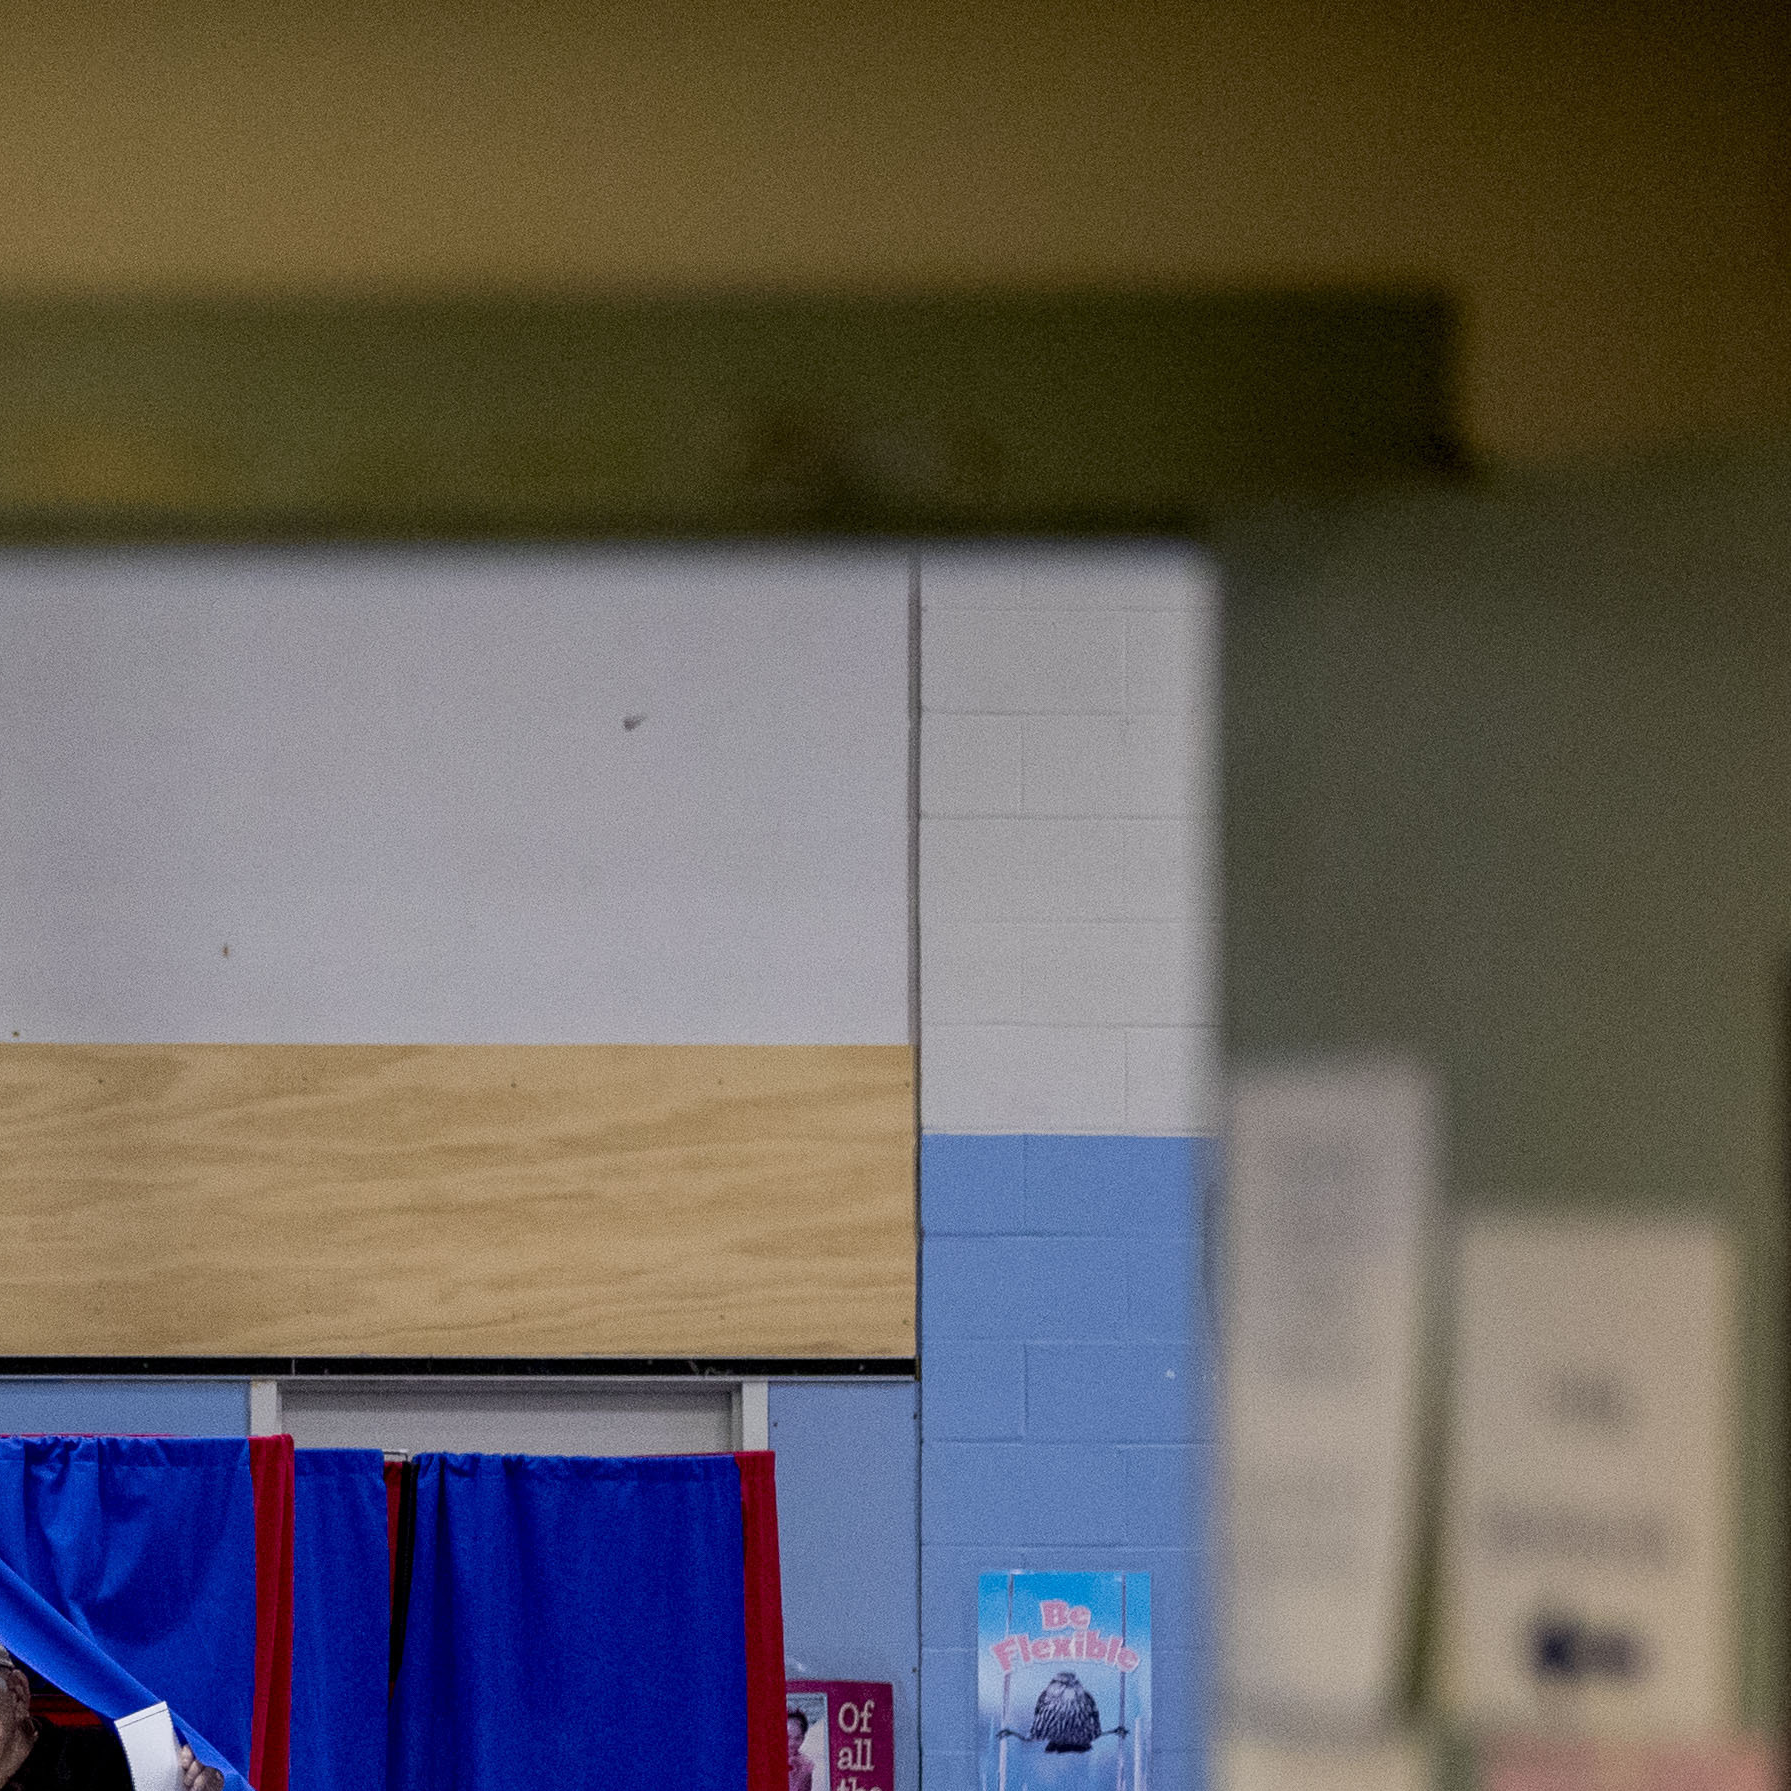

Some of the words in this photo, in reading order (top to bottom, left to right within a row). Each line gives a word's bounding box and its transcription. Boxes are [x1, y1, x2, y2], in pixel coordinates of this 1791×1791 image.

[1040, 1599, 1092, 1630] Be
[991, 1630, 1140, 1672] Flexible
[837, 1699, 875, 1734] Of
[836, 1738, 875, 1772] all
